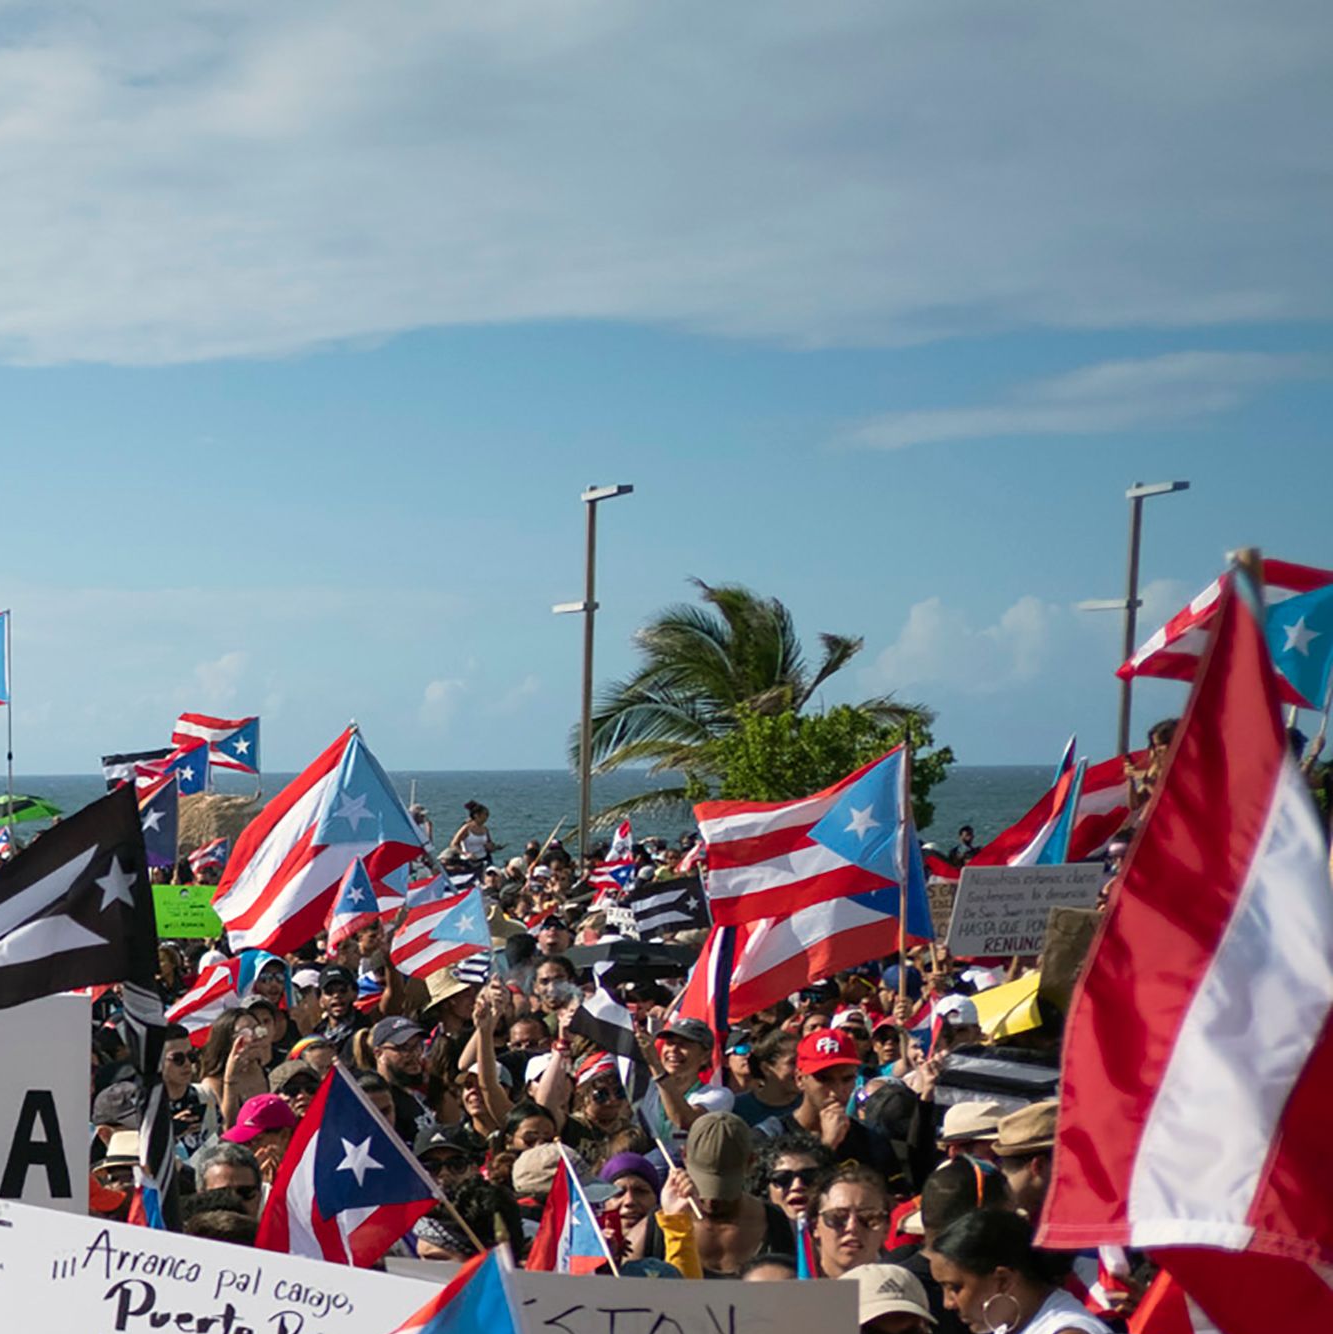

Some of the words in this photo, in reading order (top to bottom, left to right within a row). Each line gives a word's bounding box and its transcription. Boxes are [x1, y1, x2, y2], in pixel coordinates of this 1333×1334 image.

[983, 936, 1043, 953] RENUNC
[214, 1267, 261, 1299] pal
[273, 1278, 354, 1319] carajo,
